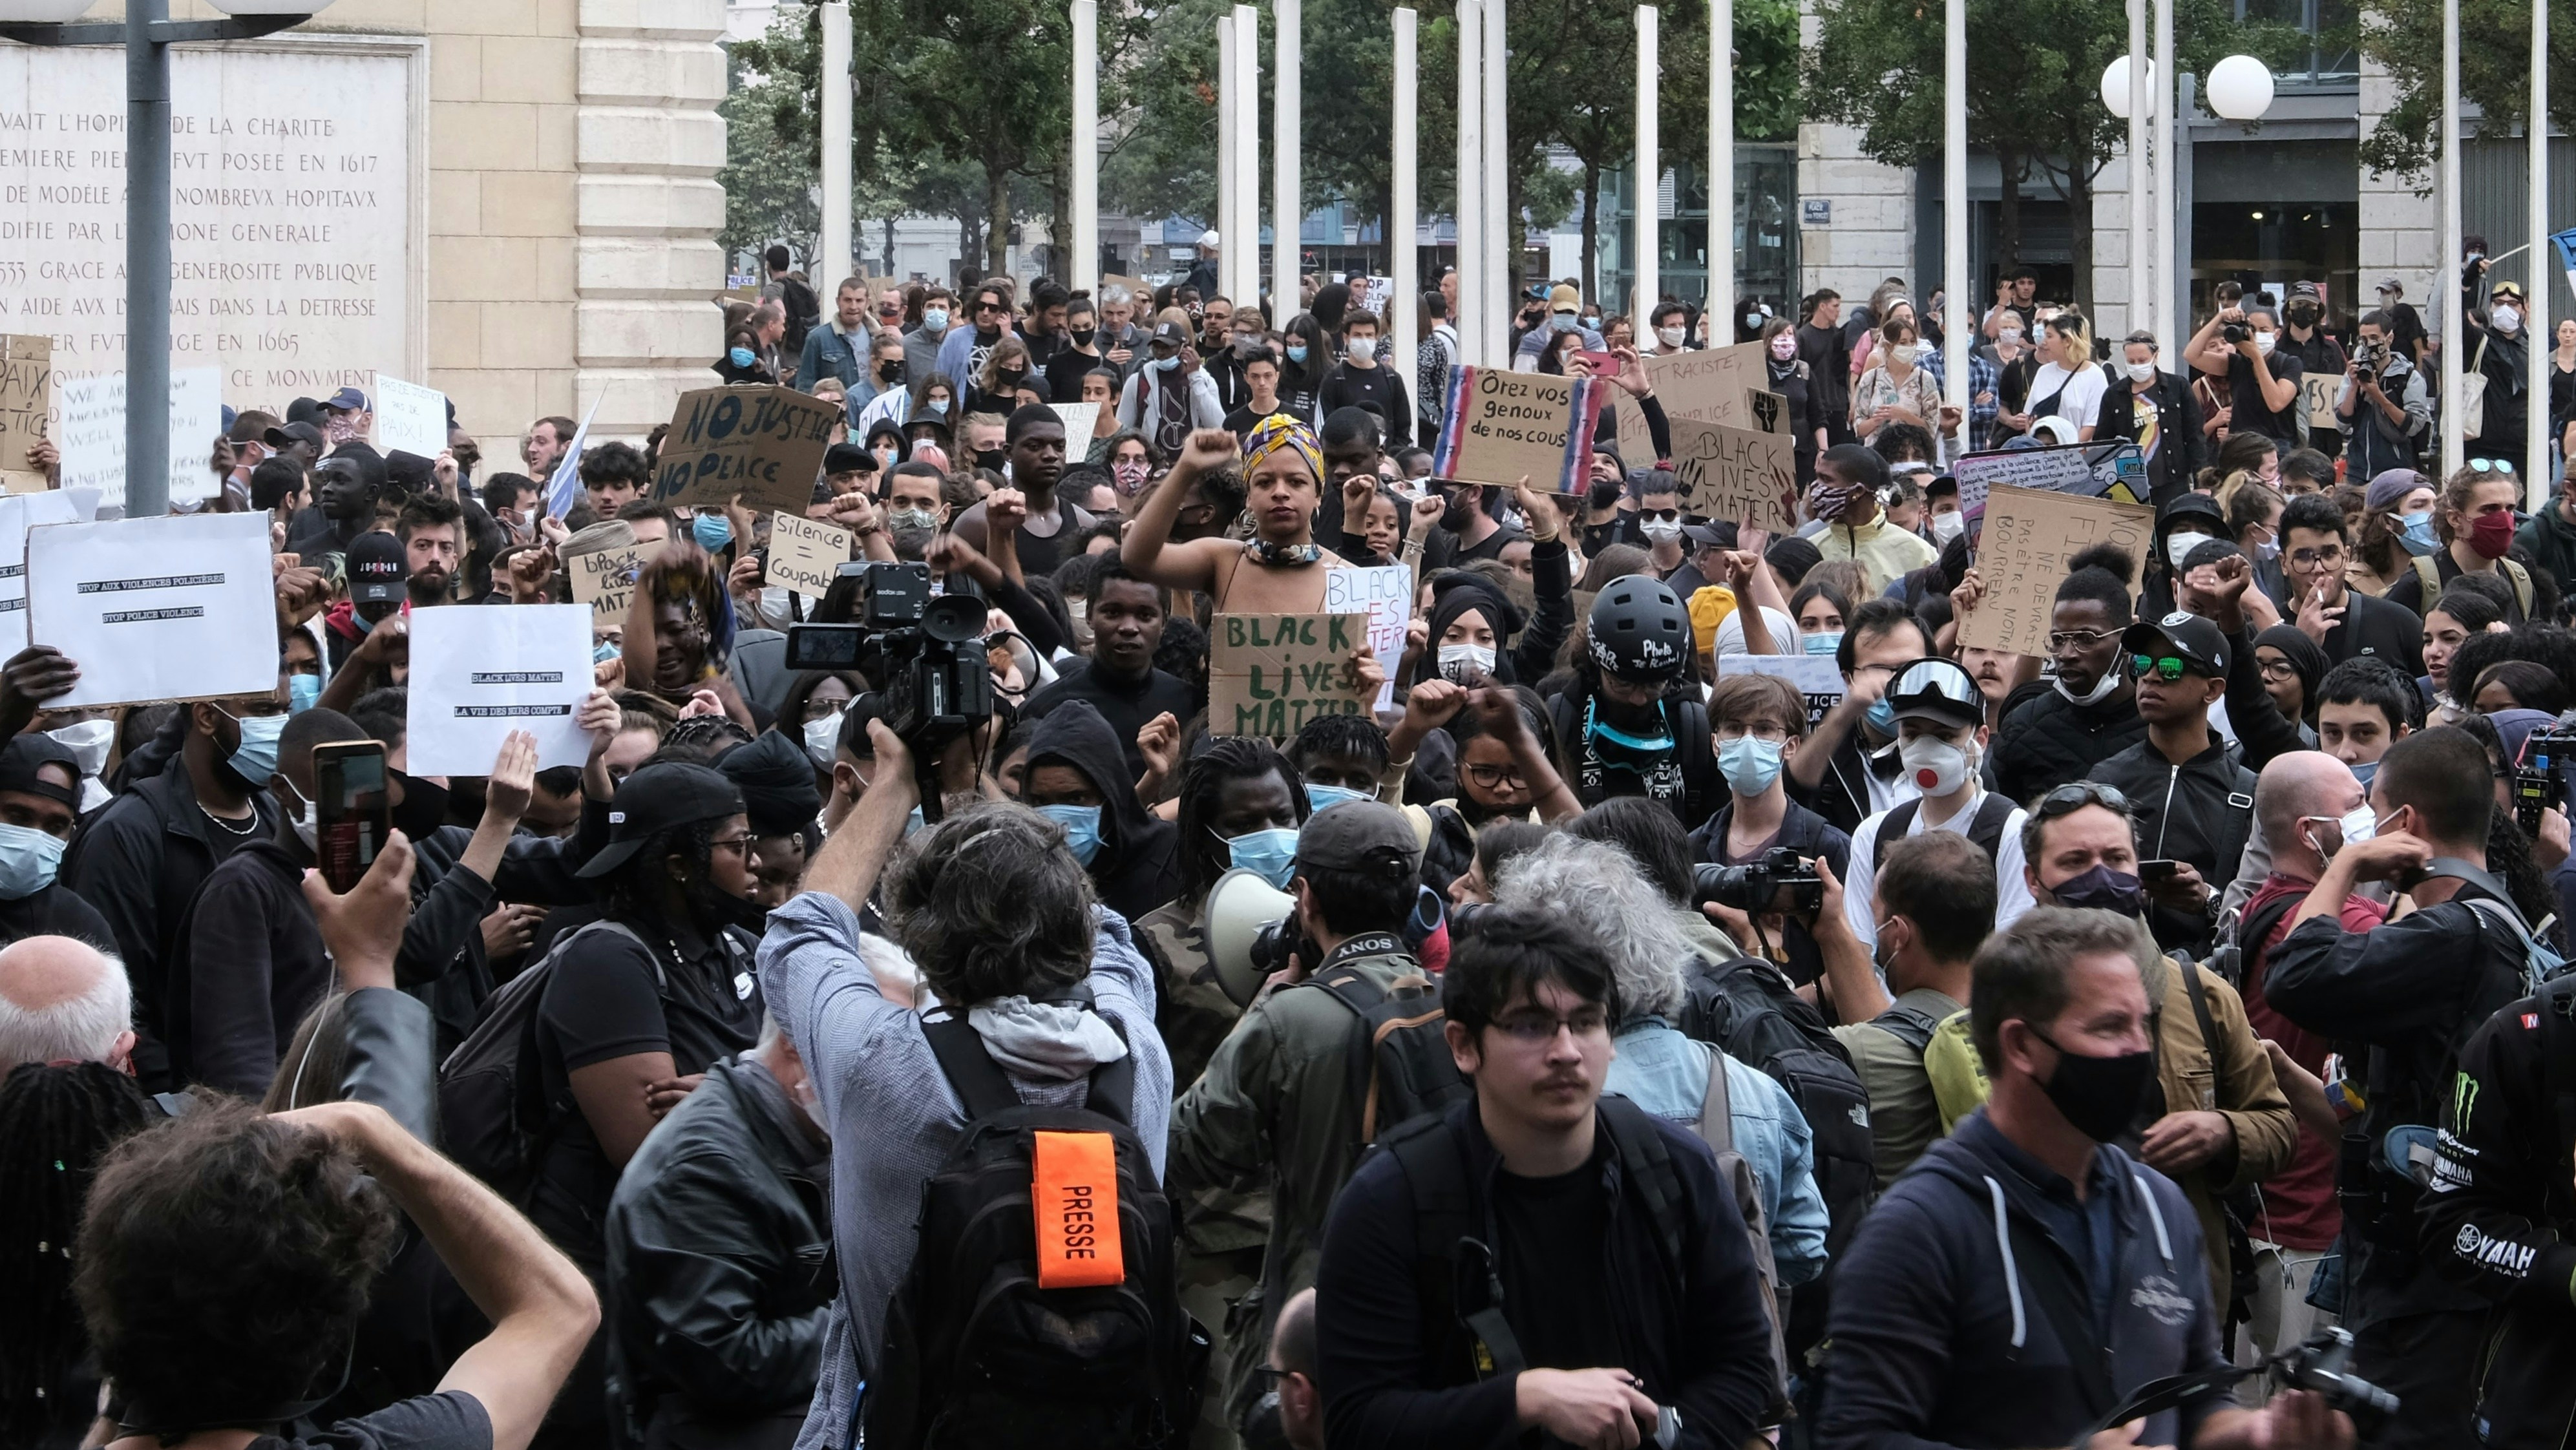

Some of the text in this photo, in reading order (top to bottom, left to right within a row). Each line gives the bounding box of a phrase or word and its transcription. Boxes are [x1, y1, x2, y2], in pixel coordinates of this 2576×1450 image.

[60, 114, 127, 132] L'HOPI
[173, 116, 195, 134] DE
[210, 117, 233, 134] LA
[248, 118, 333, 140] CHARITE
[0, 149, 377, 173] EMIERE PIE FVT POSEE EN 1617
[6, 185, 28, 203] DE
[176, 187, 274, 209] NOMBREVX
[286, 189, 377, 207] HOPITAVX
[3, 222, 332, 245] DIFIE PAR GENERALE
[40, 261, 105, 283] GRACE
[295, 263, 377, 285] PVBLIQVE
[1368, 278, 1384, 289] OP
[21, 297, 62, 316] AIDE
[72, 297, 105, 316] AVX
[209, 298, 254, 315] DANS
[266, 299, 288, 315] LA
[301, 299, 376, 319] DETRESSE
[217, 333, 242, 351] EN
[258, 328, 299, 358] 1665
[231, 369, 377, 387] CE MONVMENT
[681, 394, 743, 446] NO
[1483, 400, 1552, 421] genoux
[1470, 420, 1491, 437] de
[1496, 426, 1523, 441] nos
[1696, 431, 1777, 472] BLACK
[653, 461, 692, 503] NO
[693, 453, 781, 485] PEACE
[1702, 462, 1771, 498] LIVES
[1705, 491, 1780, 528] MATTER
[777, 515, 843, 549] Silence
[2018, 519, 2034, 543] PAS
[772, 558, 832, 589] Coupab
[1988, 516, 2014, 611] BOURREAU
[78, 574, 225, 593] STOP AUX VIOLENCES POLICIÈRES
[1329, 567, 1411, 606] BLACK
[102, 607, 204, 623] STOP POLICE VIOLENCE
[2022, 551, 2054, 655] NE DEVRAIT
[1227, 615, 1350, 654] BLACK
[472, 673, 504, 683] BLACK
[527, 673, 562, 682] MATTER
[454, 708, 469, 717] LA
[470, 707, 488, 716] VIE
[489, 707, 507, 716] DES
[531, 706, 562, 715] COMPTE
[1337, 938, 1393, 959] SONY
[1062, 1185, 1095, 1260] PRESSE
